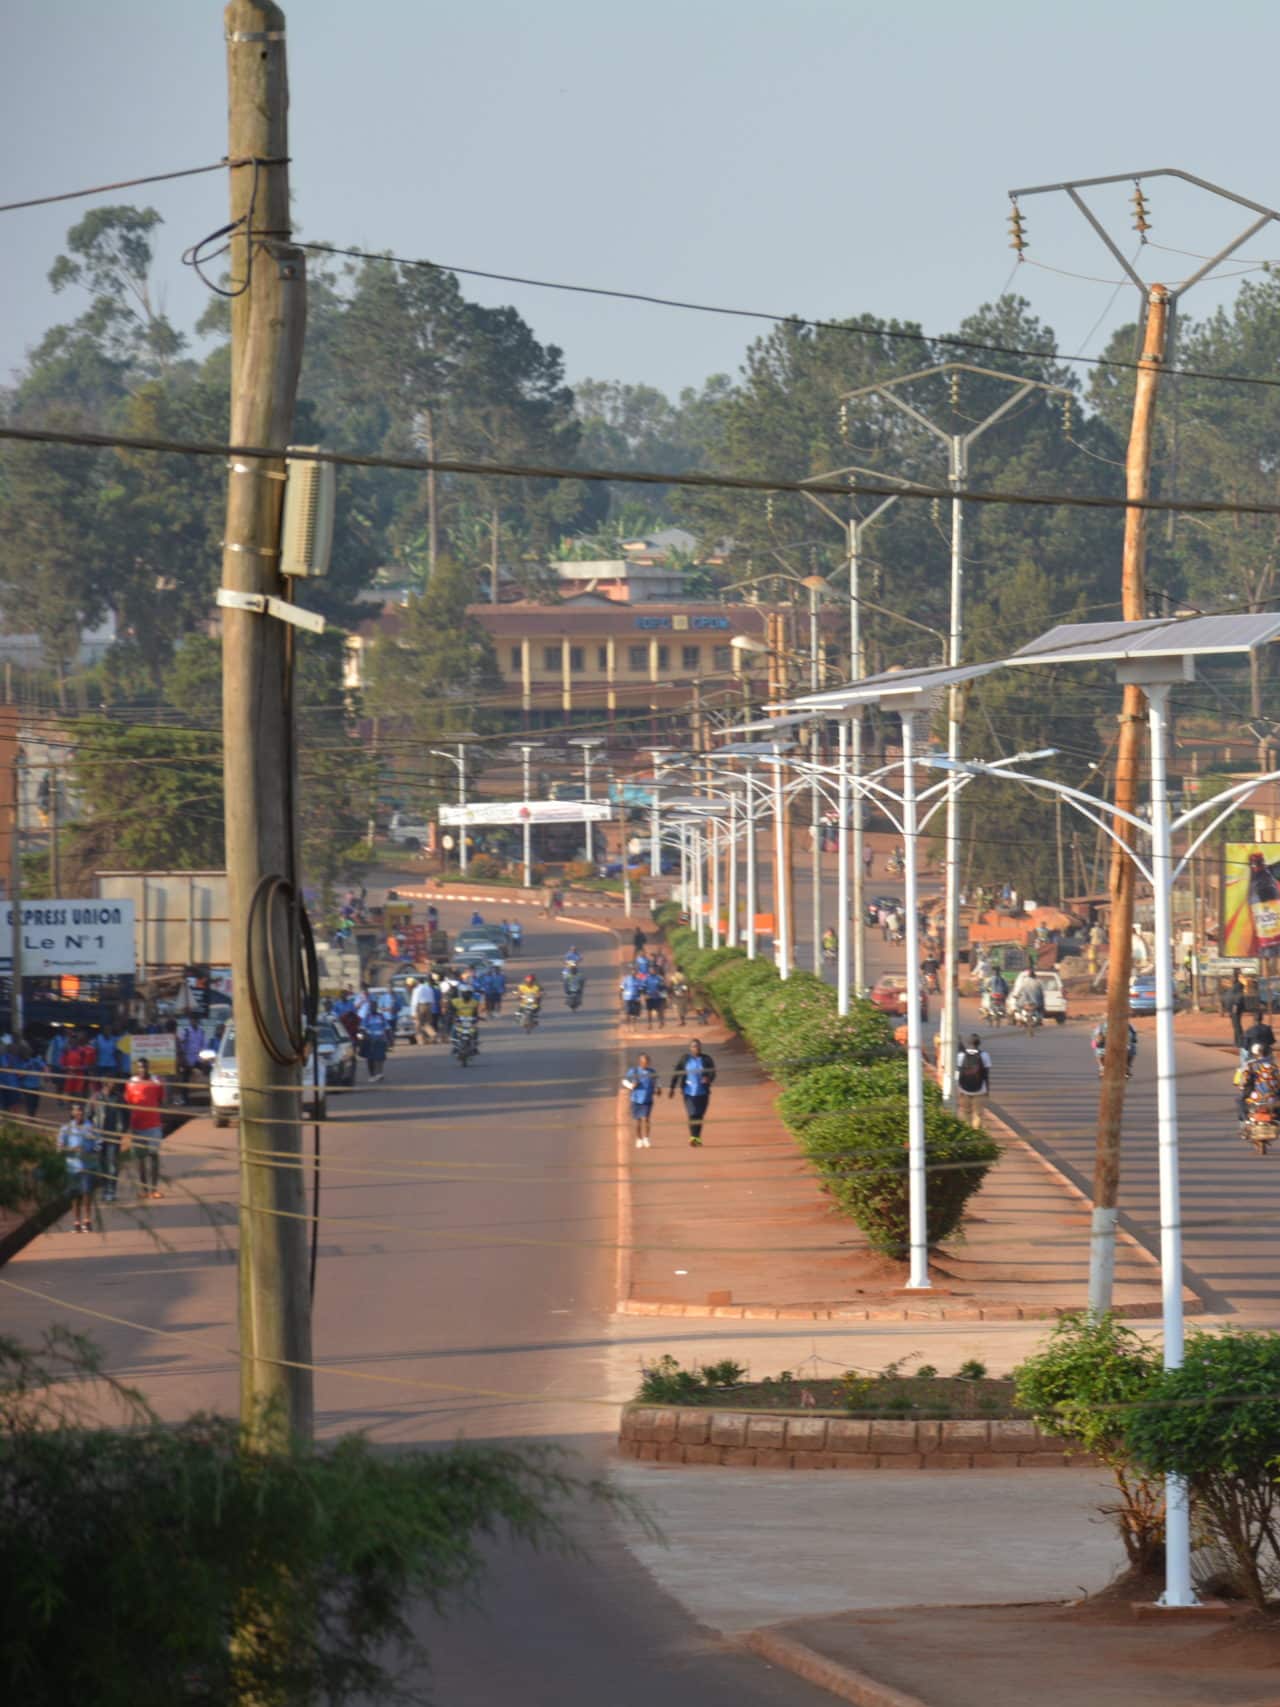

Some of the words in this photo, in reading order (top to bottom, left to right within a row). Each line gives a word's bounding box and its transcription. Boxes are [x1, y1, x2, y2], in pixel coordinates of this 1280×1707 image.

[7, 908, 67, 926] EPRESS
[71, 907, 121, 925] UNION
[24, 935, 56, 950] Le
